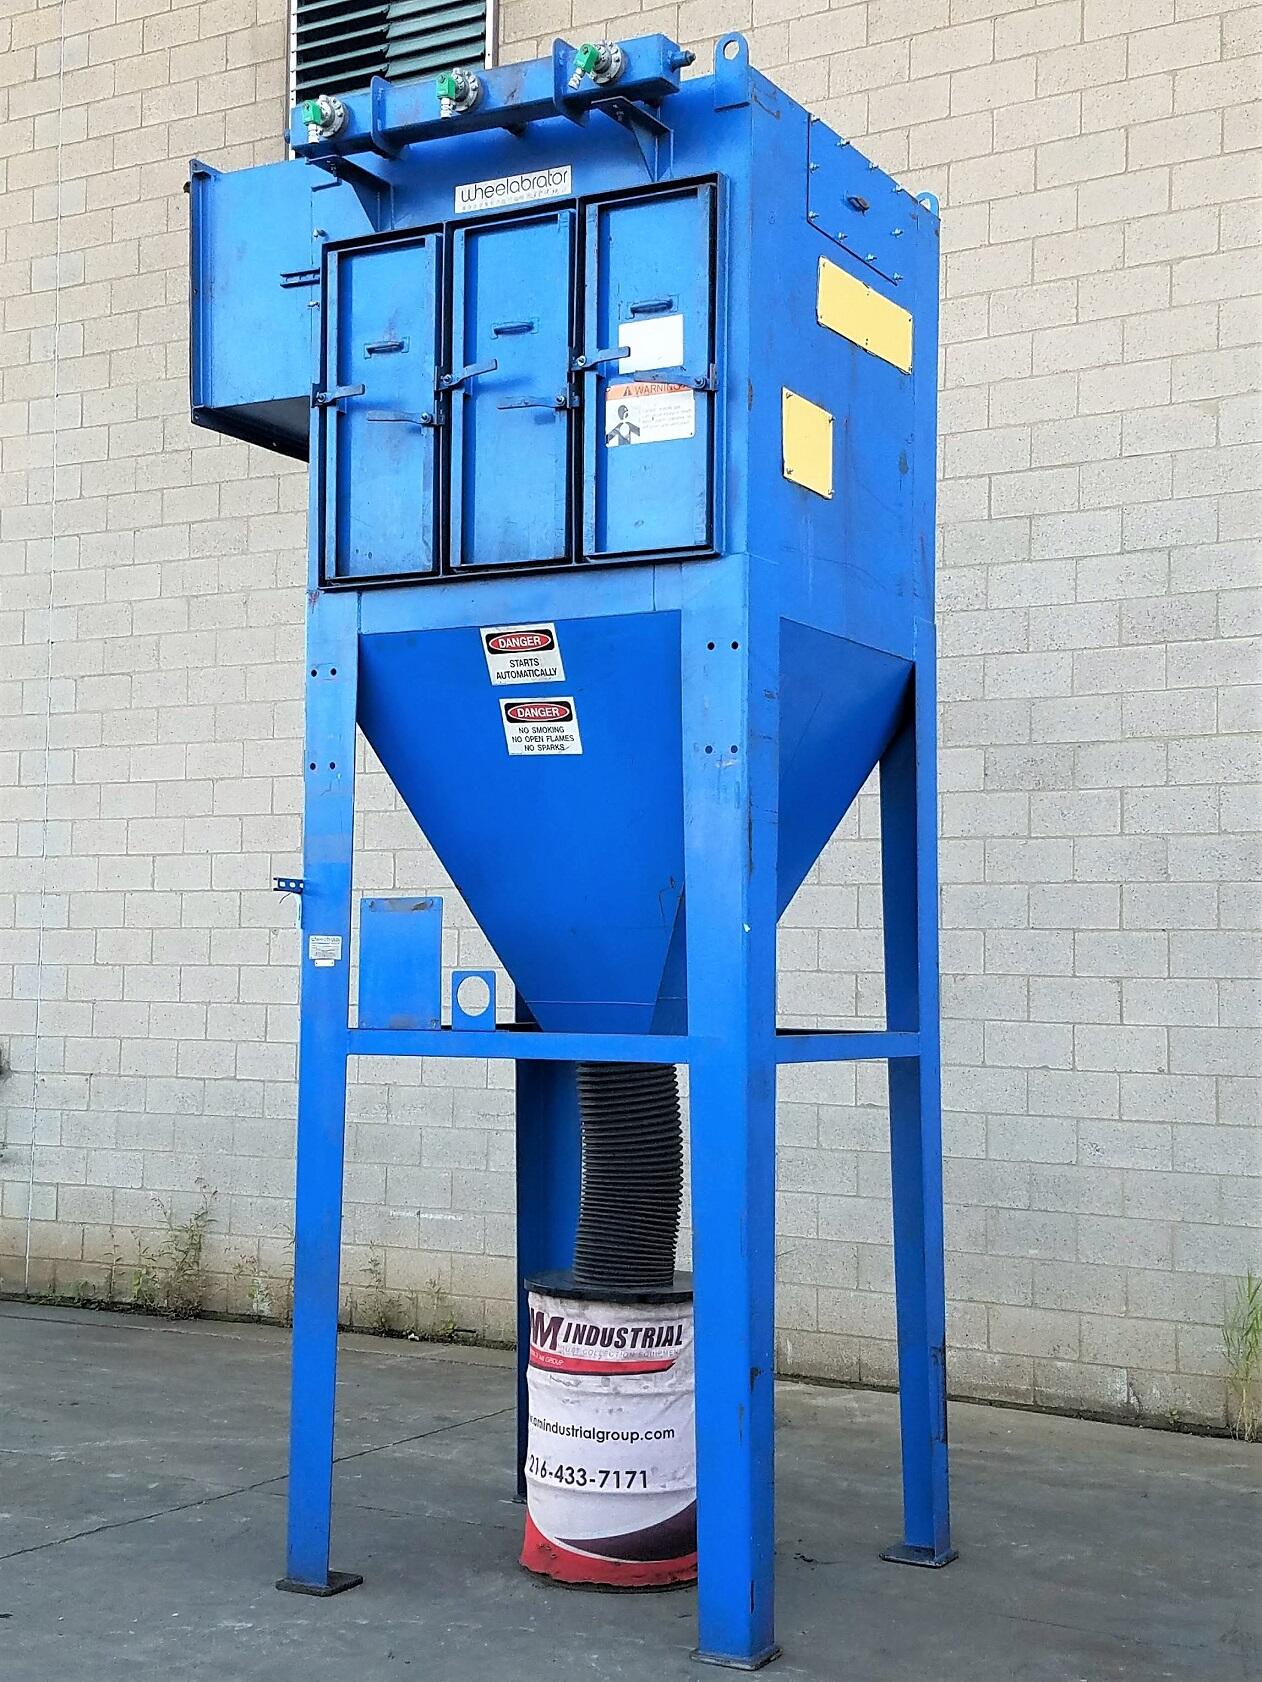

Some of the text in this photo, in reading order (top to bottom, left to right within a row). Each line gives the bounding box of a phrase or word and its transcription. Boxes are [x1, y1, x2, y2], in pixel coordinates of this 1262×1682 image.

[461, 169, 568, 203] wheelabrator
[498, 635, 542, 649] DANGER
[509, 657, 540, 668] STARTS
[496, 667, 557, 680] AUTOMATICALLY
[517, 706, 560, 718] DANGER
[518, 725, 565, 734] NO SMOKING
[524, 735, 544, 743] OPEN
[546, 735, 575, 743] FLAMES
[524, 743, 565, 752] NO SPARKS
[562, 1322, 683, 1349] INDUSTRIAL
[529, 1454, 649, 1489] 216-433-7171
